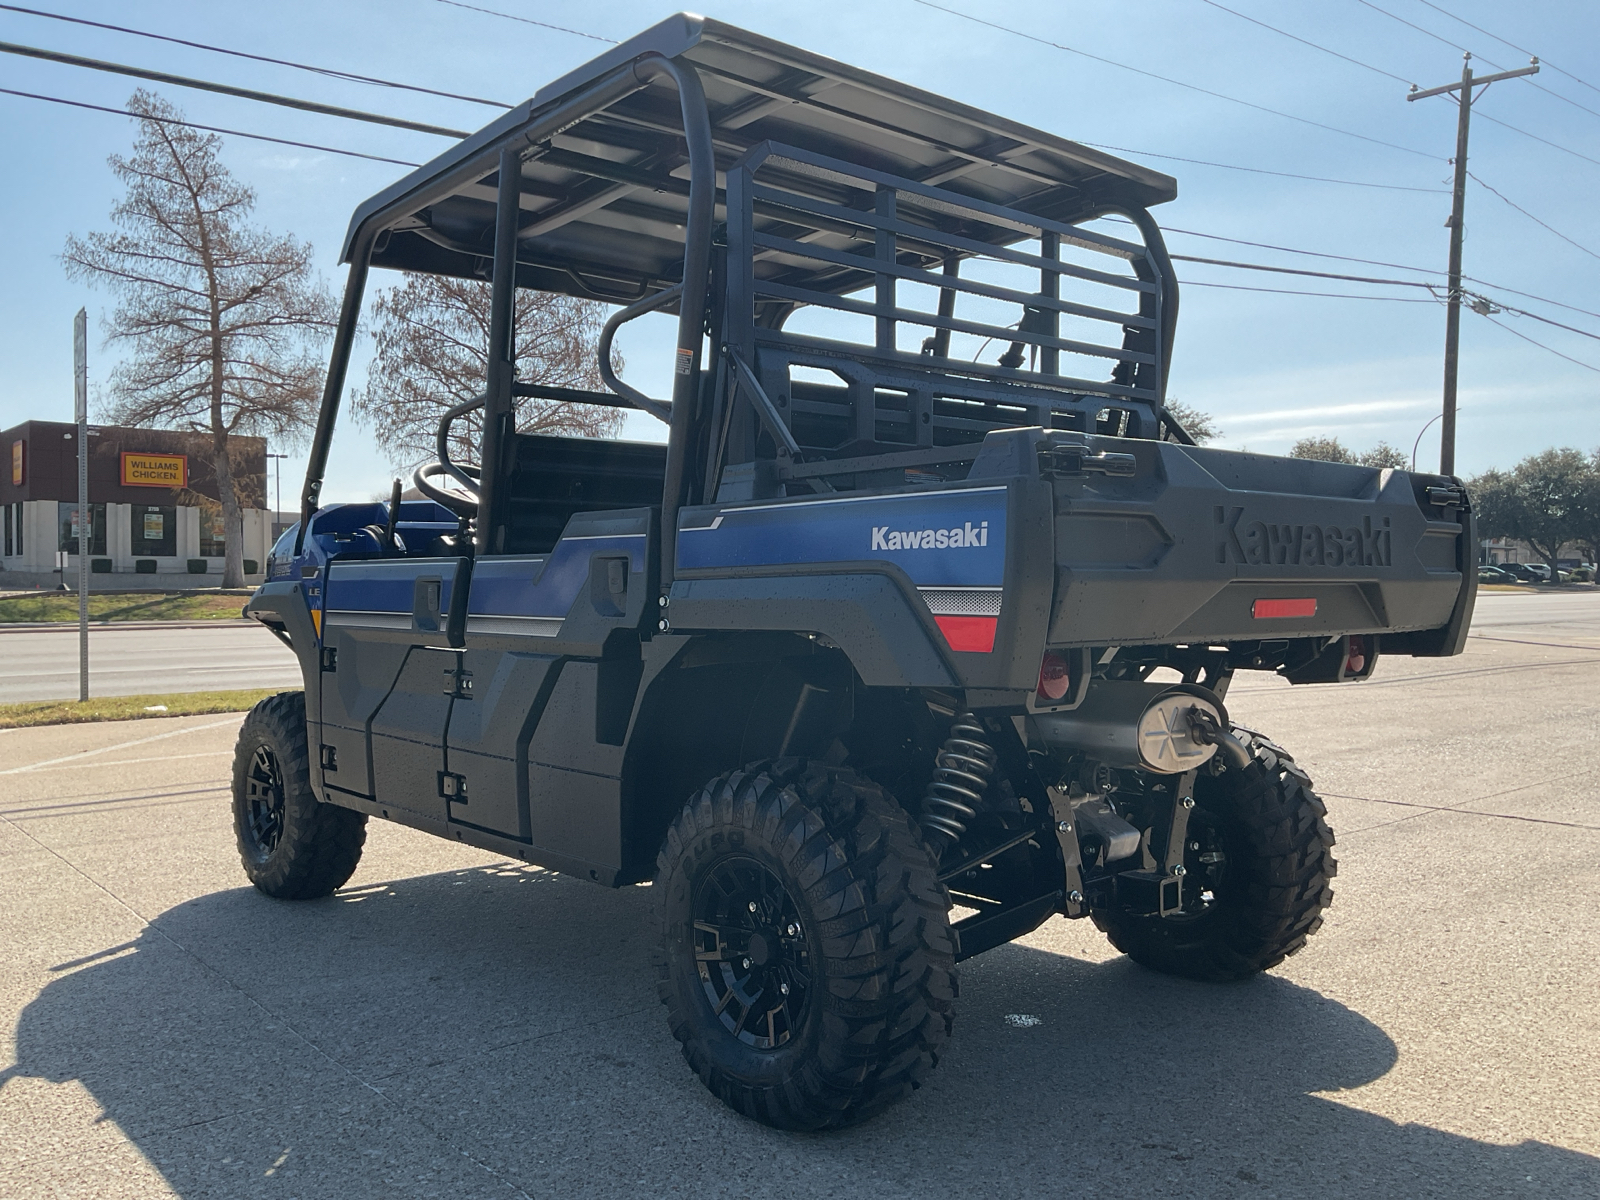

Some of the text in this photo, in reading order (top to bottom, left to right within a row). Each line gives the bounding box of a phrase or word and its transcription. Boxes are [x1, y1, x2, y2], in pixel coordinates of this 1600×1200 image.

[131, 461, 179, 471] WILLIAMS
[871, 521, 988, 550] Kawasaki
[1213, 505, 1392, 567] Kawasaki
[309, 588, 320, 596] LE
